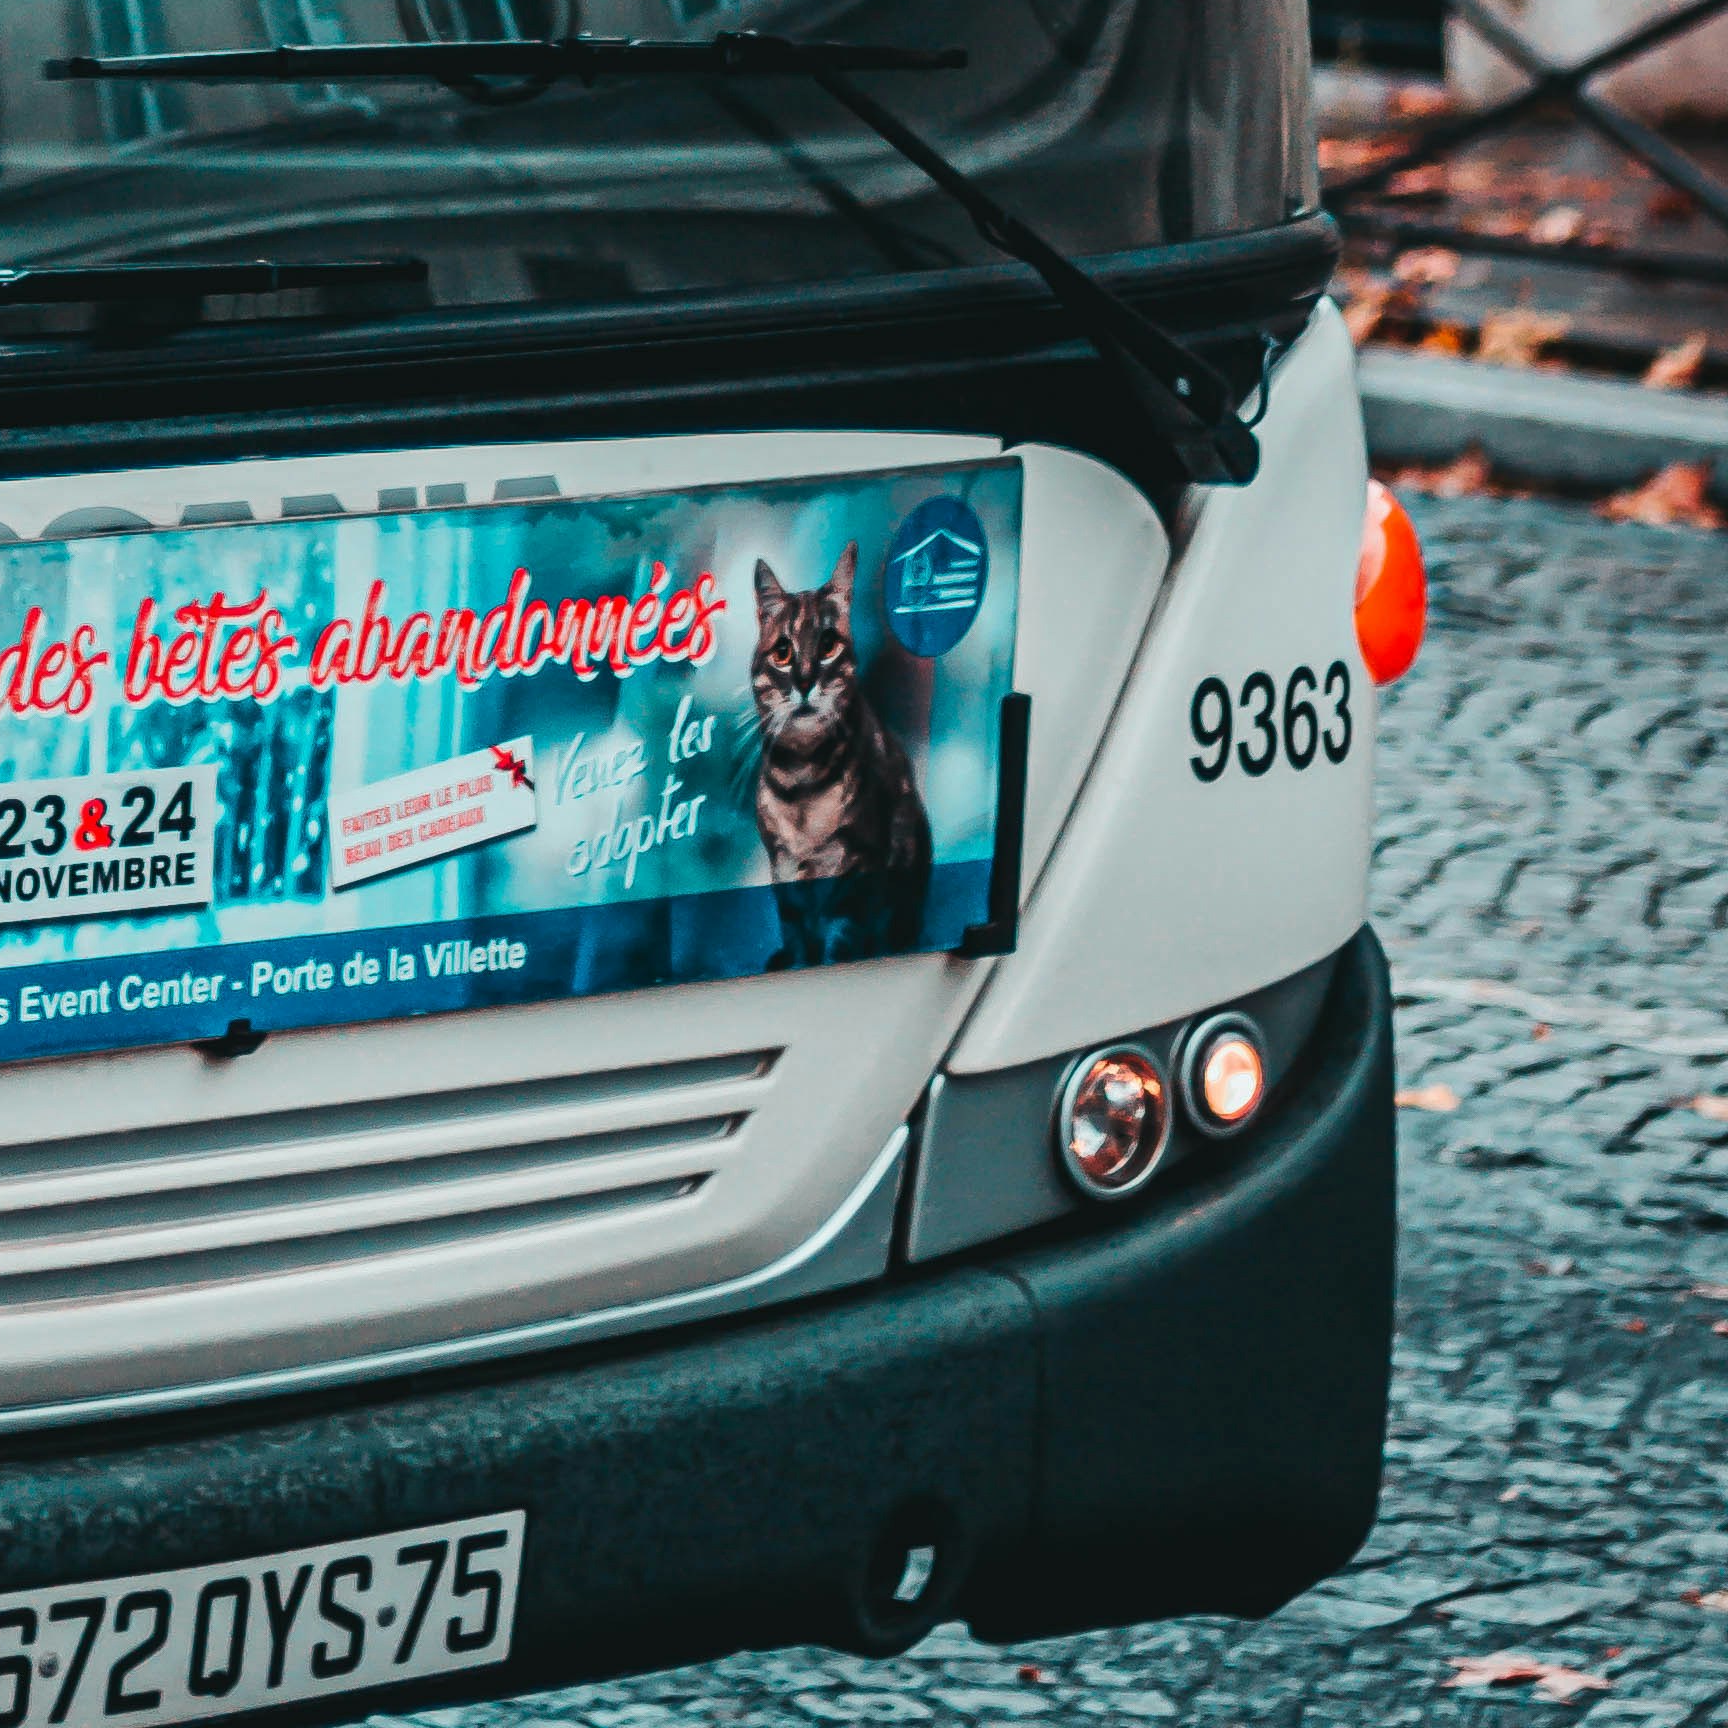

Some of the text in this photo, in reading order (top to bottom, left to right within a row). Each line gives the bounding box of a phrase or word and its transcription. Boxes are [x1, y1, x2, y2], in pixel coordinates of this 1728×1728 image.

[124, 588, 296, 706] bêtes
[309, 561, 726, 689] abandonnées
[668, 694, 716, 764] les
[1189, 660, 1352, 783] 9363
[567, 772, 707, 890] adopter
[19, 981, 111, 1022] Event
[117, 971, 225, 1012] Center
[250, 957, 334, 997] Porte
[342, 950, 381, 987] de
[387, 946, 418, 982] la
[423, 937, 529, 978] Villette
